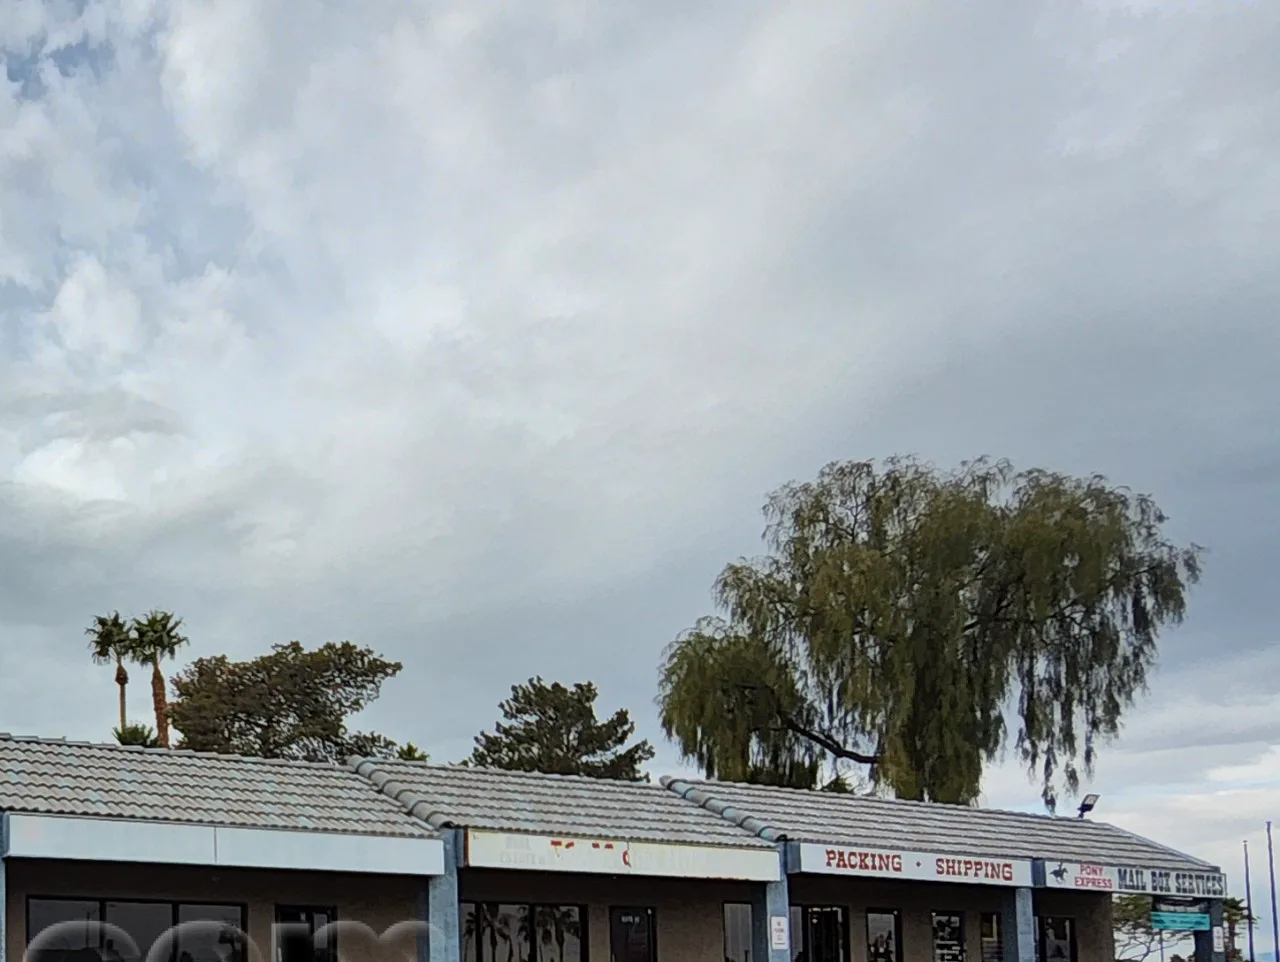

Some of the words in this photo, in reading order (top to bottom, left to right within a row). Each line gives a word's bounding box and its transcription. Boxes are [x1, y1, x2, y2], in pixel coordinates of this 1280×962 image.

[825, 849, 902, 872] PACKING
[935, 858, 1013, 881] SHIPPING
[1080, 864, 1103, 877] PONY
[1074, 877, 1113, 889] EXPRESS
[1118, 868, 1146, 891] MAIL
[1151, 872, 1172, 892] BOX
[1175, 873, 1223, 896] SERVICES
